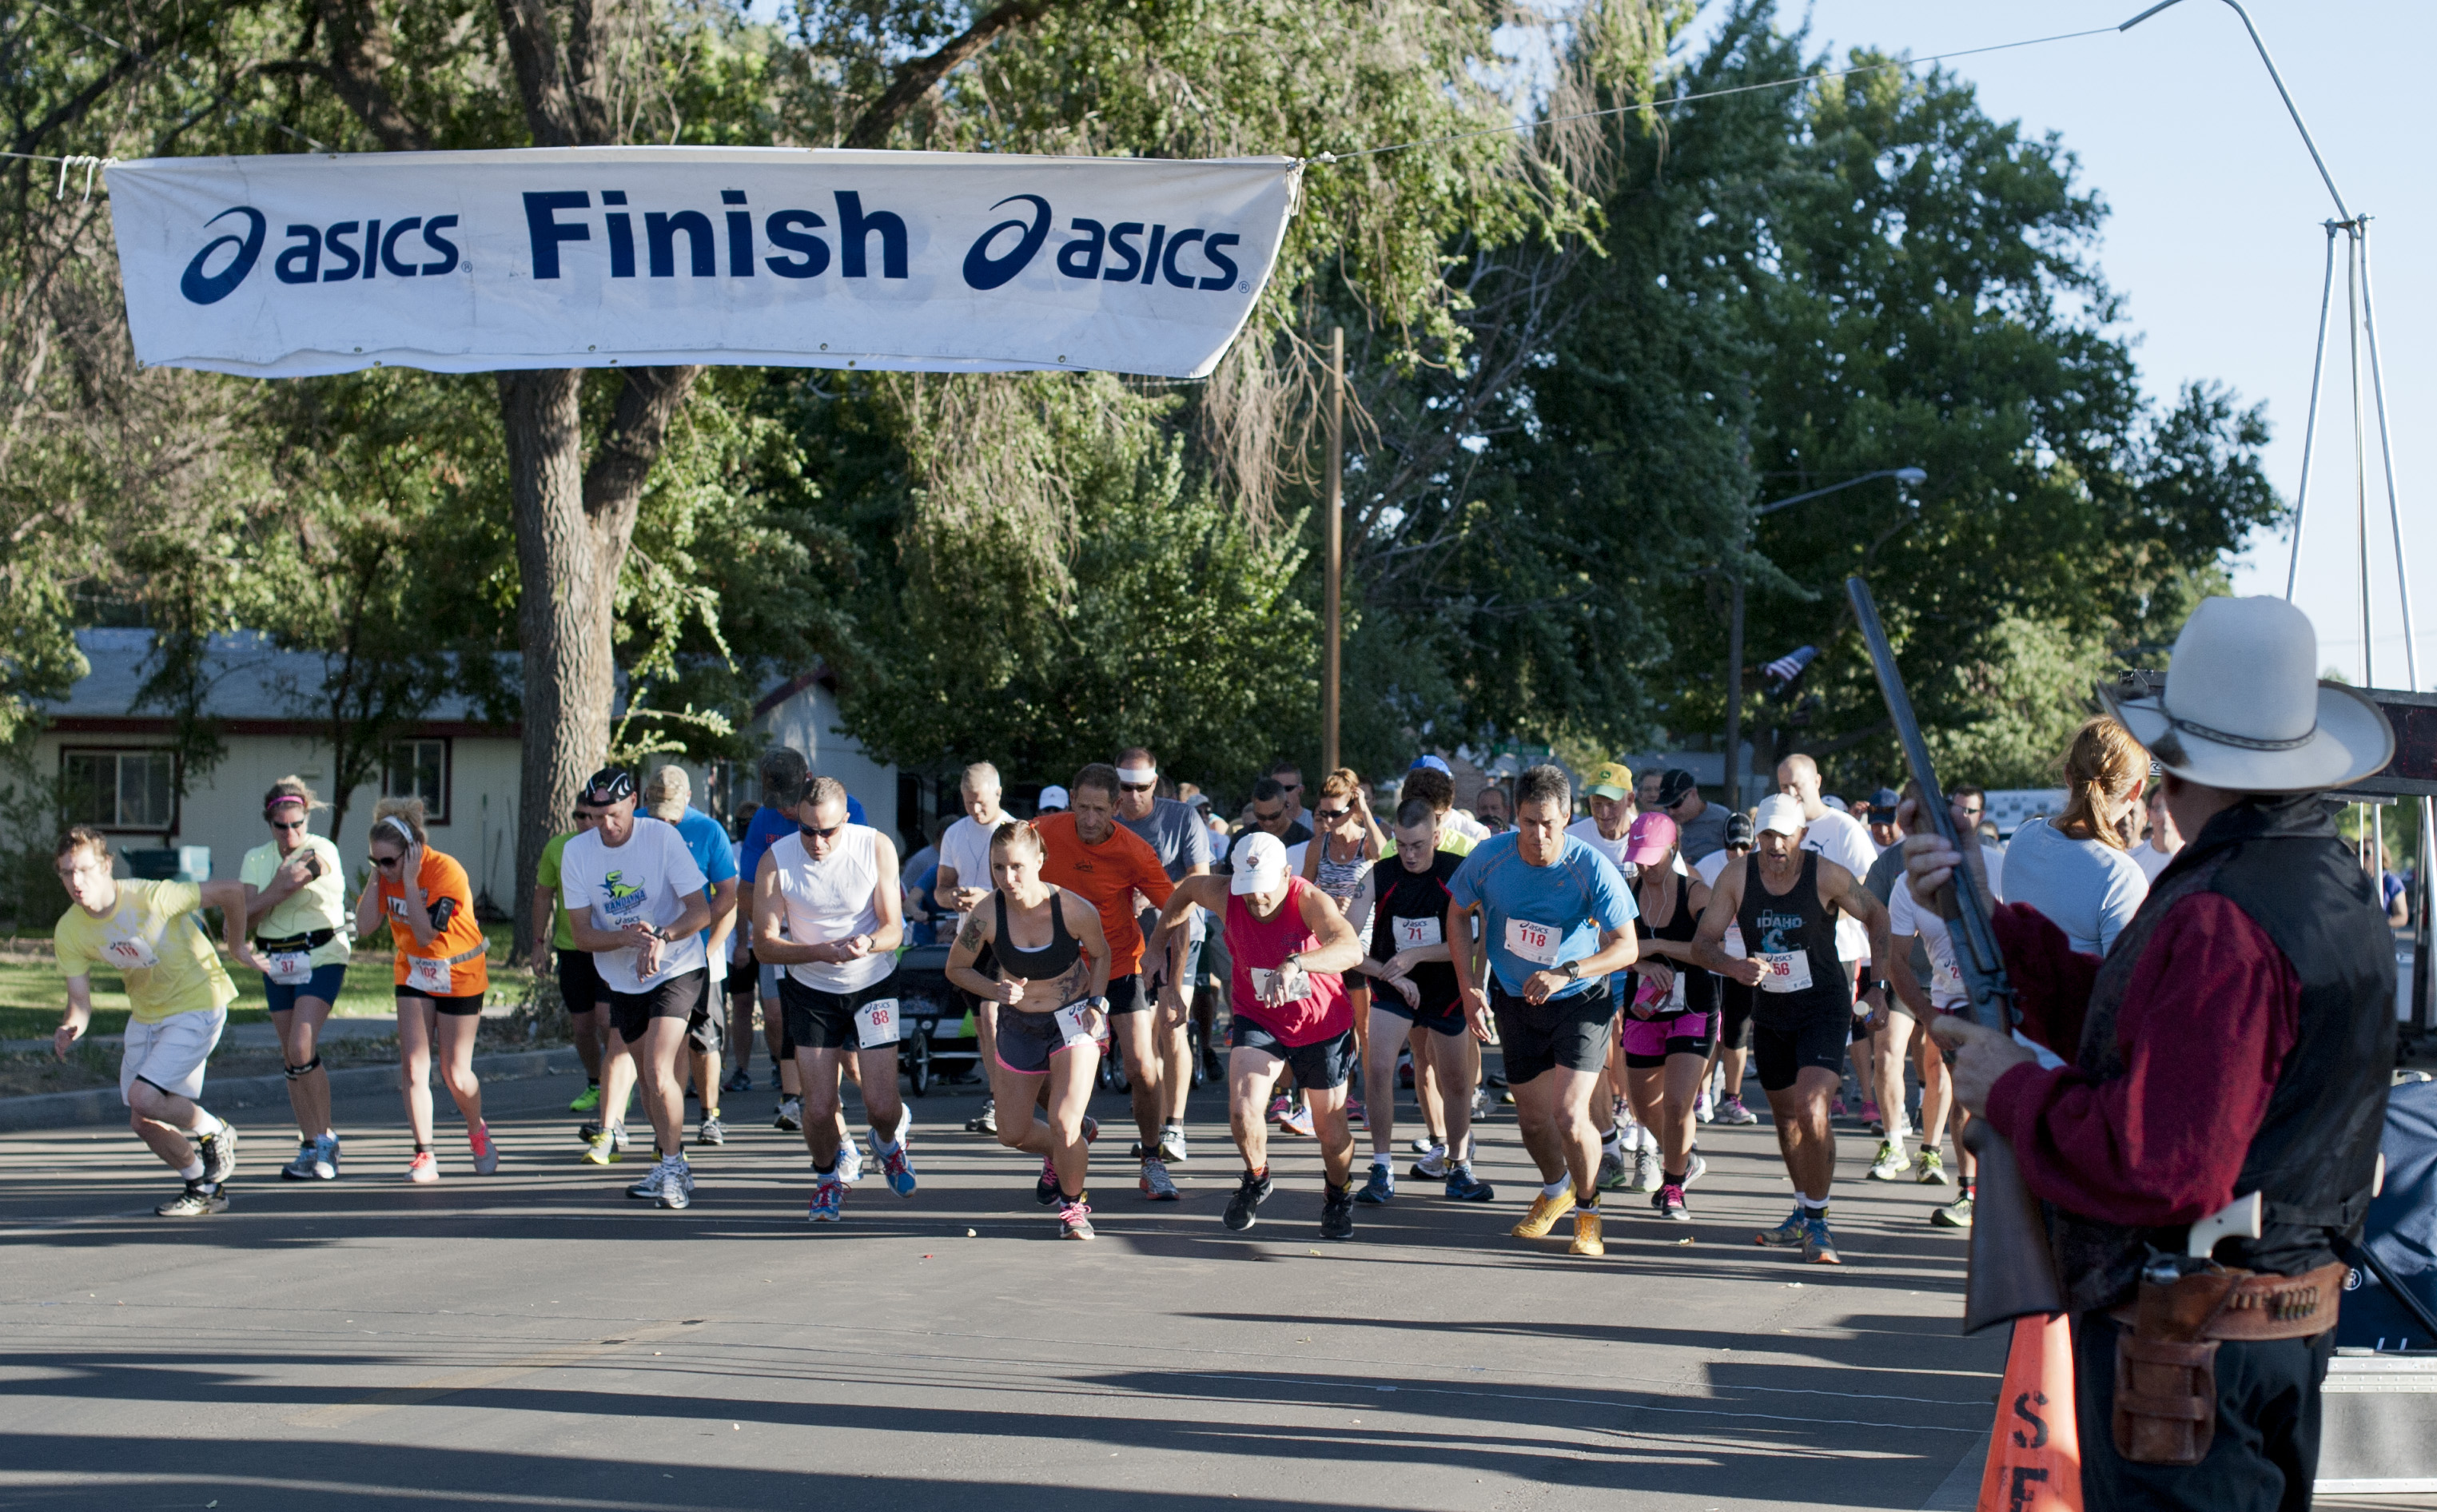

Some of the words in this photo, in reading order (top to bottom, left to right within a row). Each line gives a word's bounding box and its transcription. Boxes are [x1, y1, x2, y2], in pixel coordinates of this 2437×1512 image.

[522, 190, 908, 280] Finish
[1757, 917, 1802, 928] IDAHO
[1408, 928, 1422, 940] 71
[1522, 929, 1546, 947] 118
[420, 965, 437, 979] 102
[1772, 962, 1790, 976] 56
[872, 1010, 889, 1025] 88
